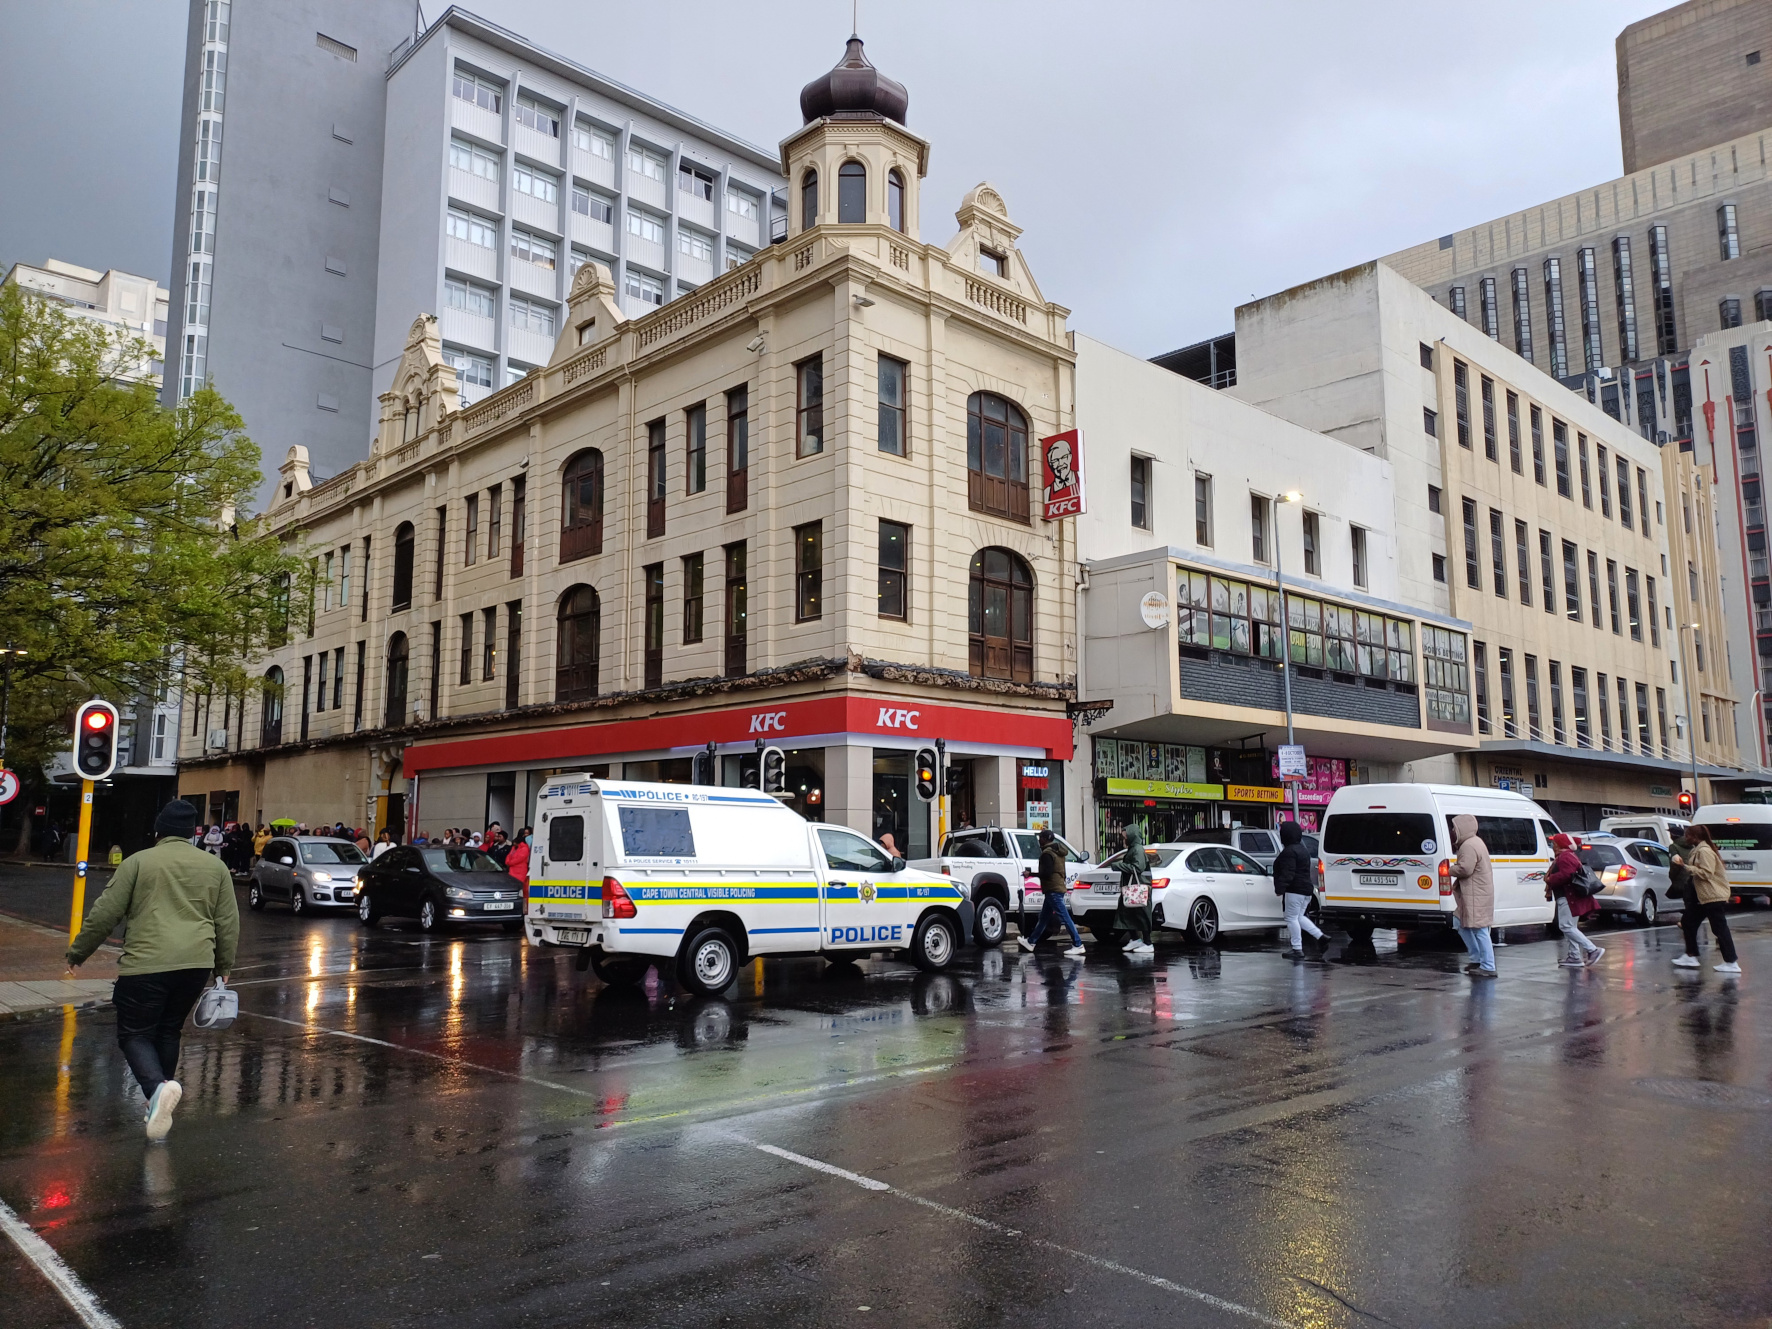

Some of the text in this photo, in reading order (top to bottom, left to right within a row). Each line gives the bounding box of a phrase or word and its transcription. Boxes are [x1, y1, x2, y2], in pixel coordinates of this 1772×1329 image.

[1047, 498, 1078, 516] KFC
[1311, 636, 1321, 650] ON
[749, 711, 787, 733] KFC
[876, 707, 921, 730] KFC
[1023, 766, 1049, 777] HELLO
[638, 790, 683, 801] POLICE
[1165, 783, 1193, 796] Styles
[1233, 787, 1255, 799] SPORTS
[1256, 788, 1279, 800] BETTING
[86, 794, 91, 802] 2
[1298, 792, 1323, 803] Exceeding
[1420, 878, 1429, 886] 100
[547, 886, 582, 898] POLICE
[642, 888, 756, 899] CAPE TOWN CENTRAL VISIBLE POLICING
[831, 925, 902, 943] POLICE
